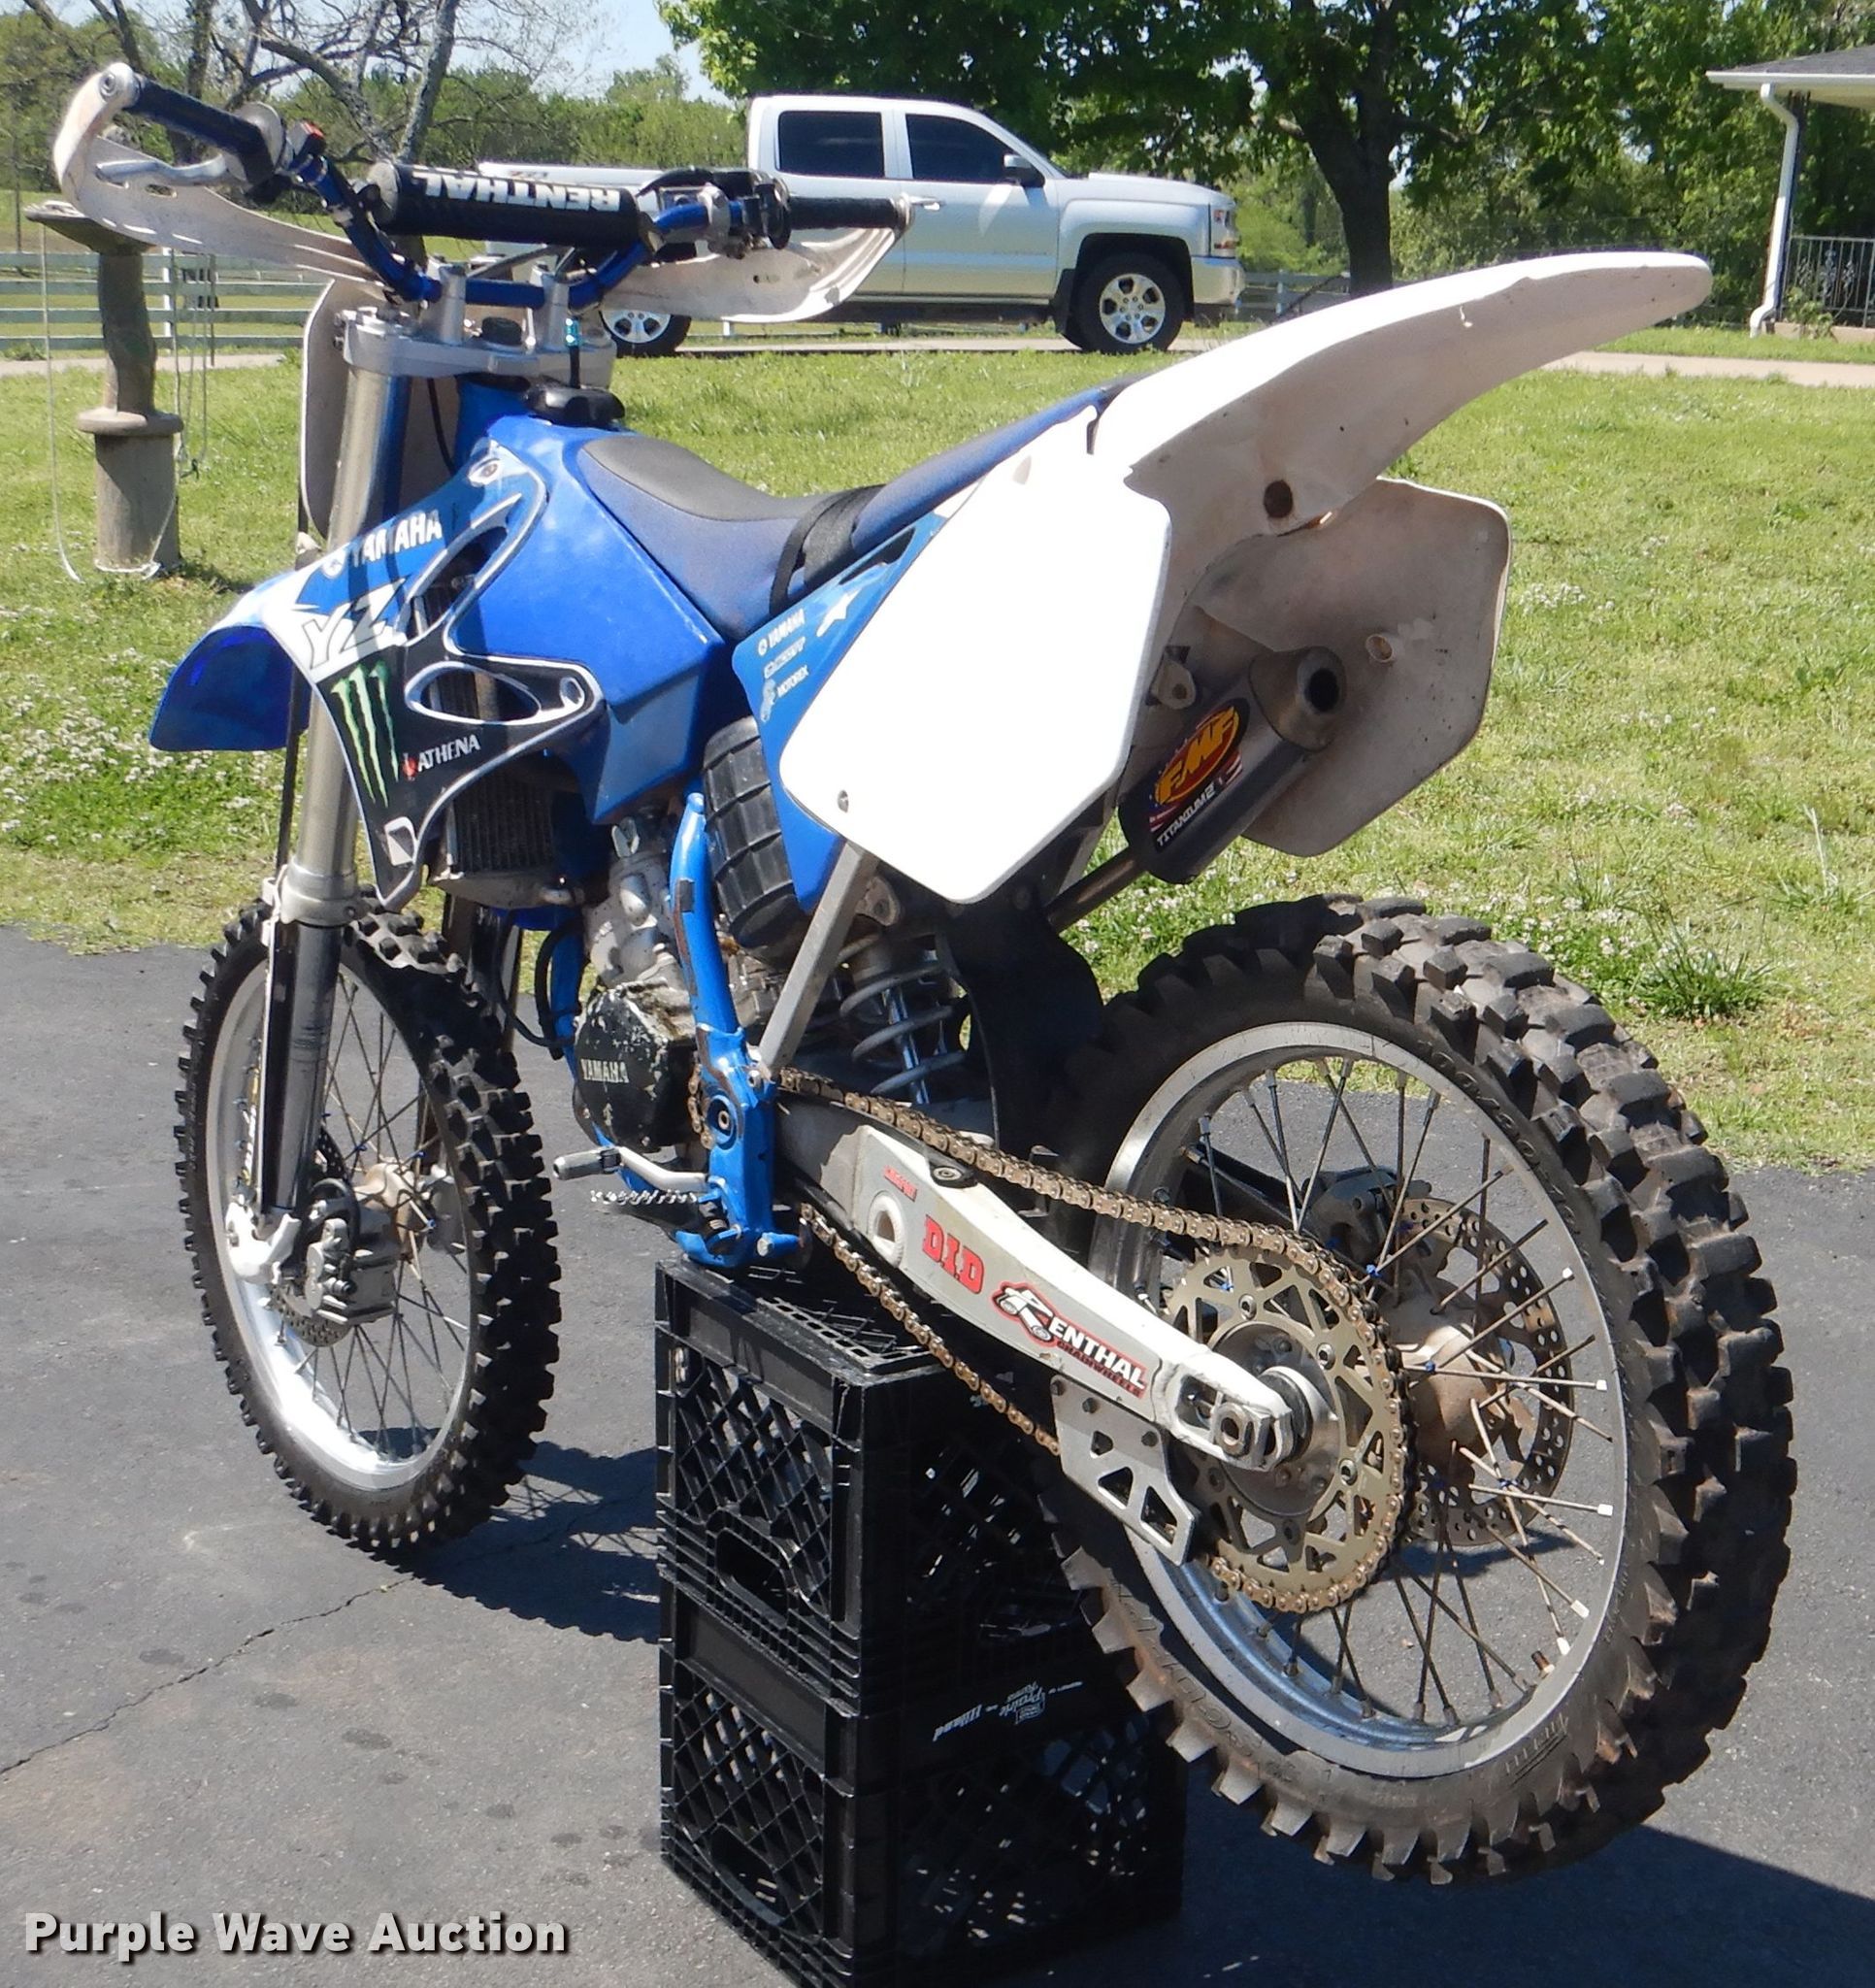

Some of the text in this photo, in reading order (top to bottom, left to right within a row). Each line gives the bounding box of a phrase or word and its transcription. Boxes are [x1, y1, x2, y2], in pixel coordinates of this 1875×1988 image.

[412, 171, 620, 212] RENTHAL
[349, 509, 443, 568] YAMAHA
[302, 574, 411, 670] YZ
[417, 734, 481, 773] ATHENA
[580, 1059, 630, 1083] YAMAHA
